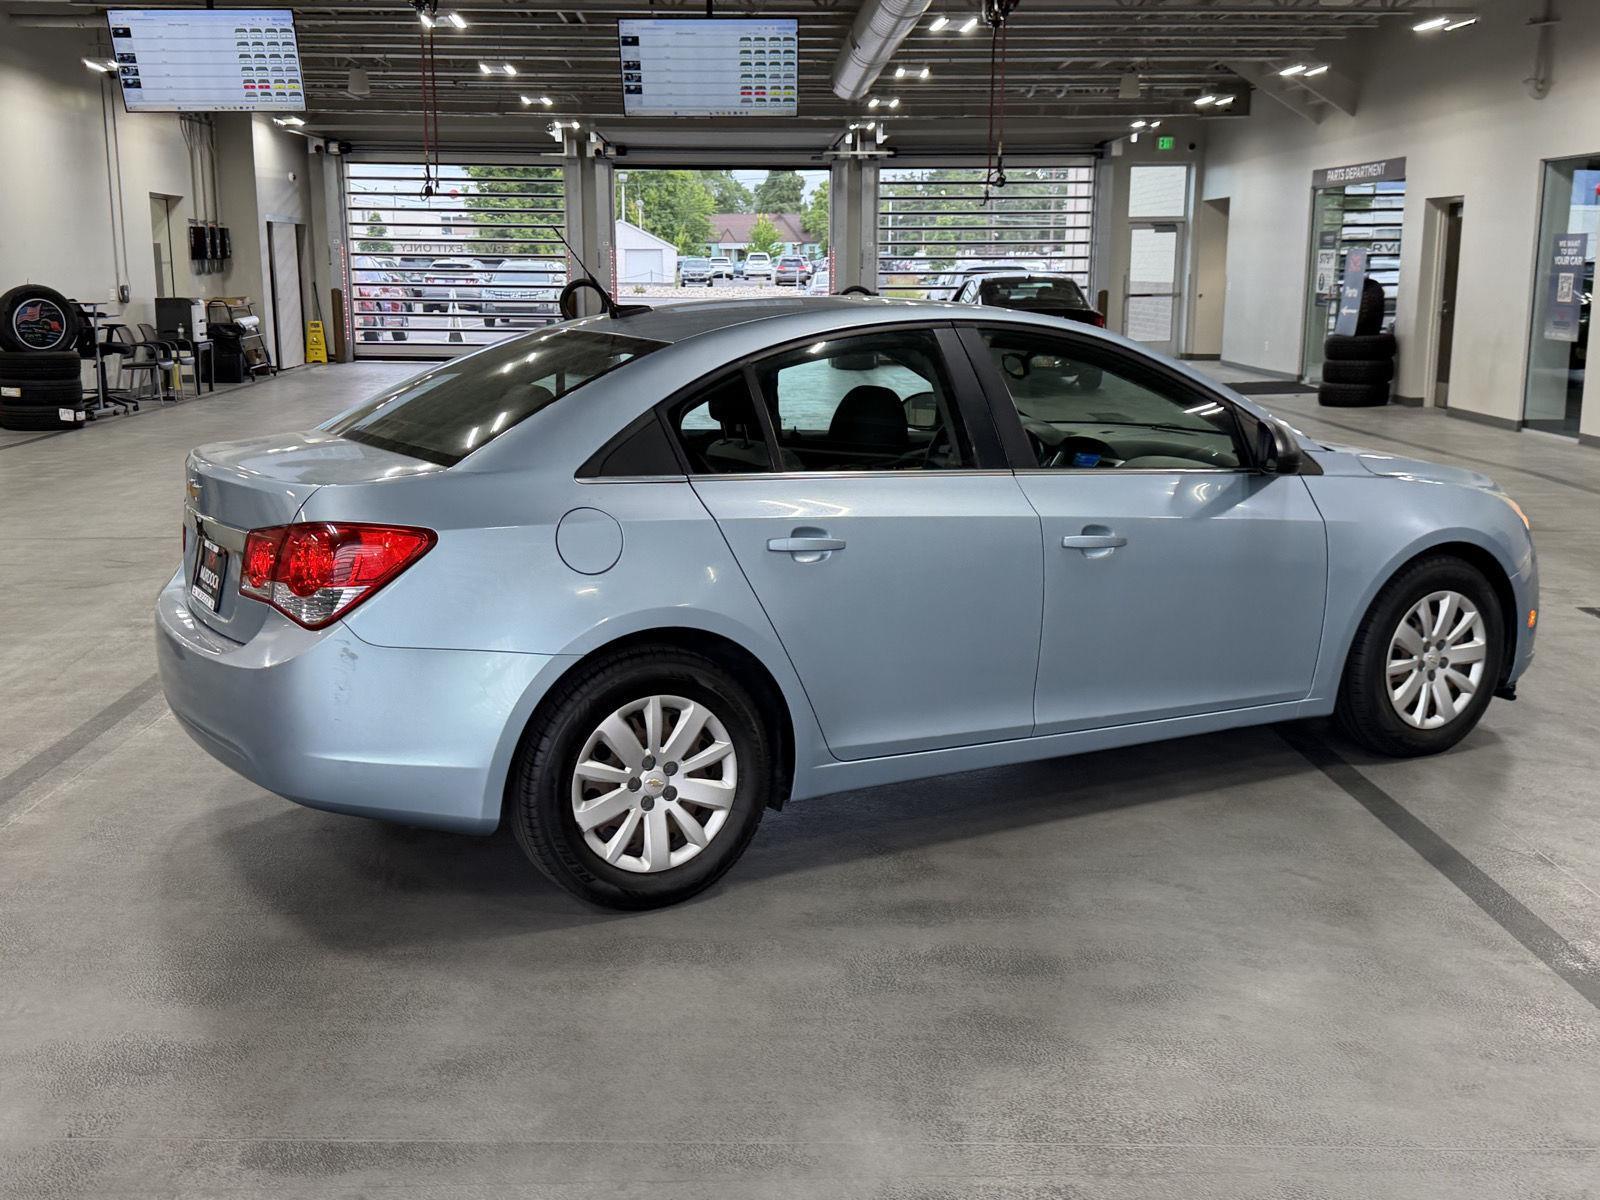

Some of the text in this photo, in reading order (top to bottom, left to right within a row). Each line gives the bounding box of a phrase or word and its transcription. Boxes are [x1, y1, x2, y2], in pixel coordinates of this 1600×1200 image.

[1327, 162, 1386, 181] PARTS DEPARTMENT
[1554, 256, 1583, 266] YOUR CAR
